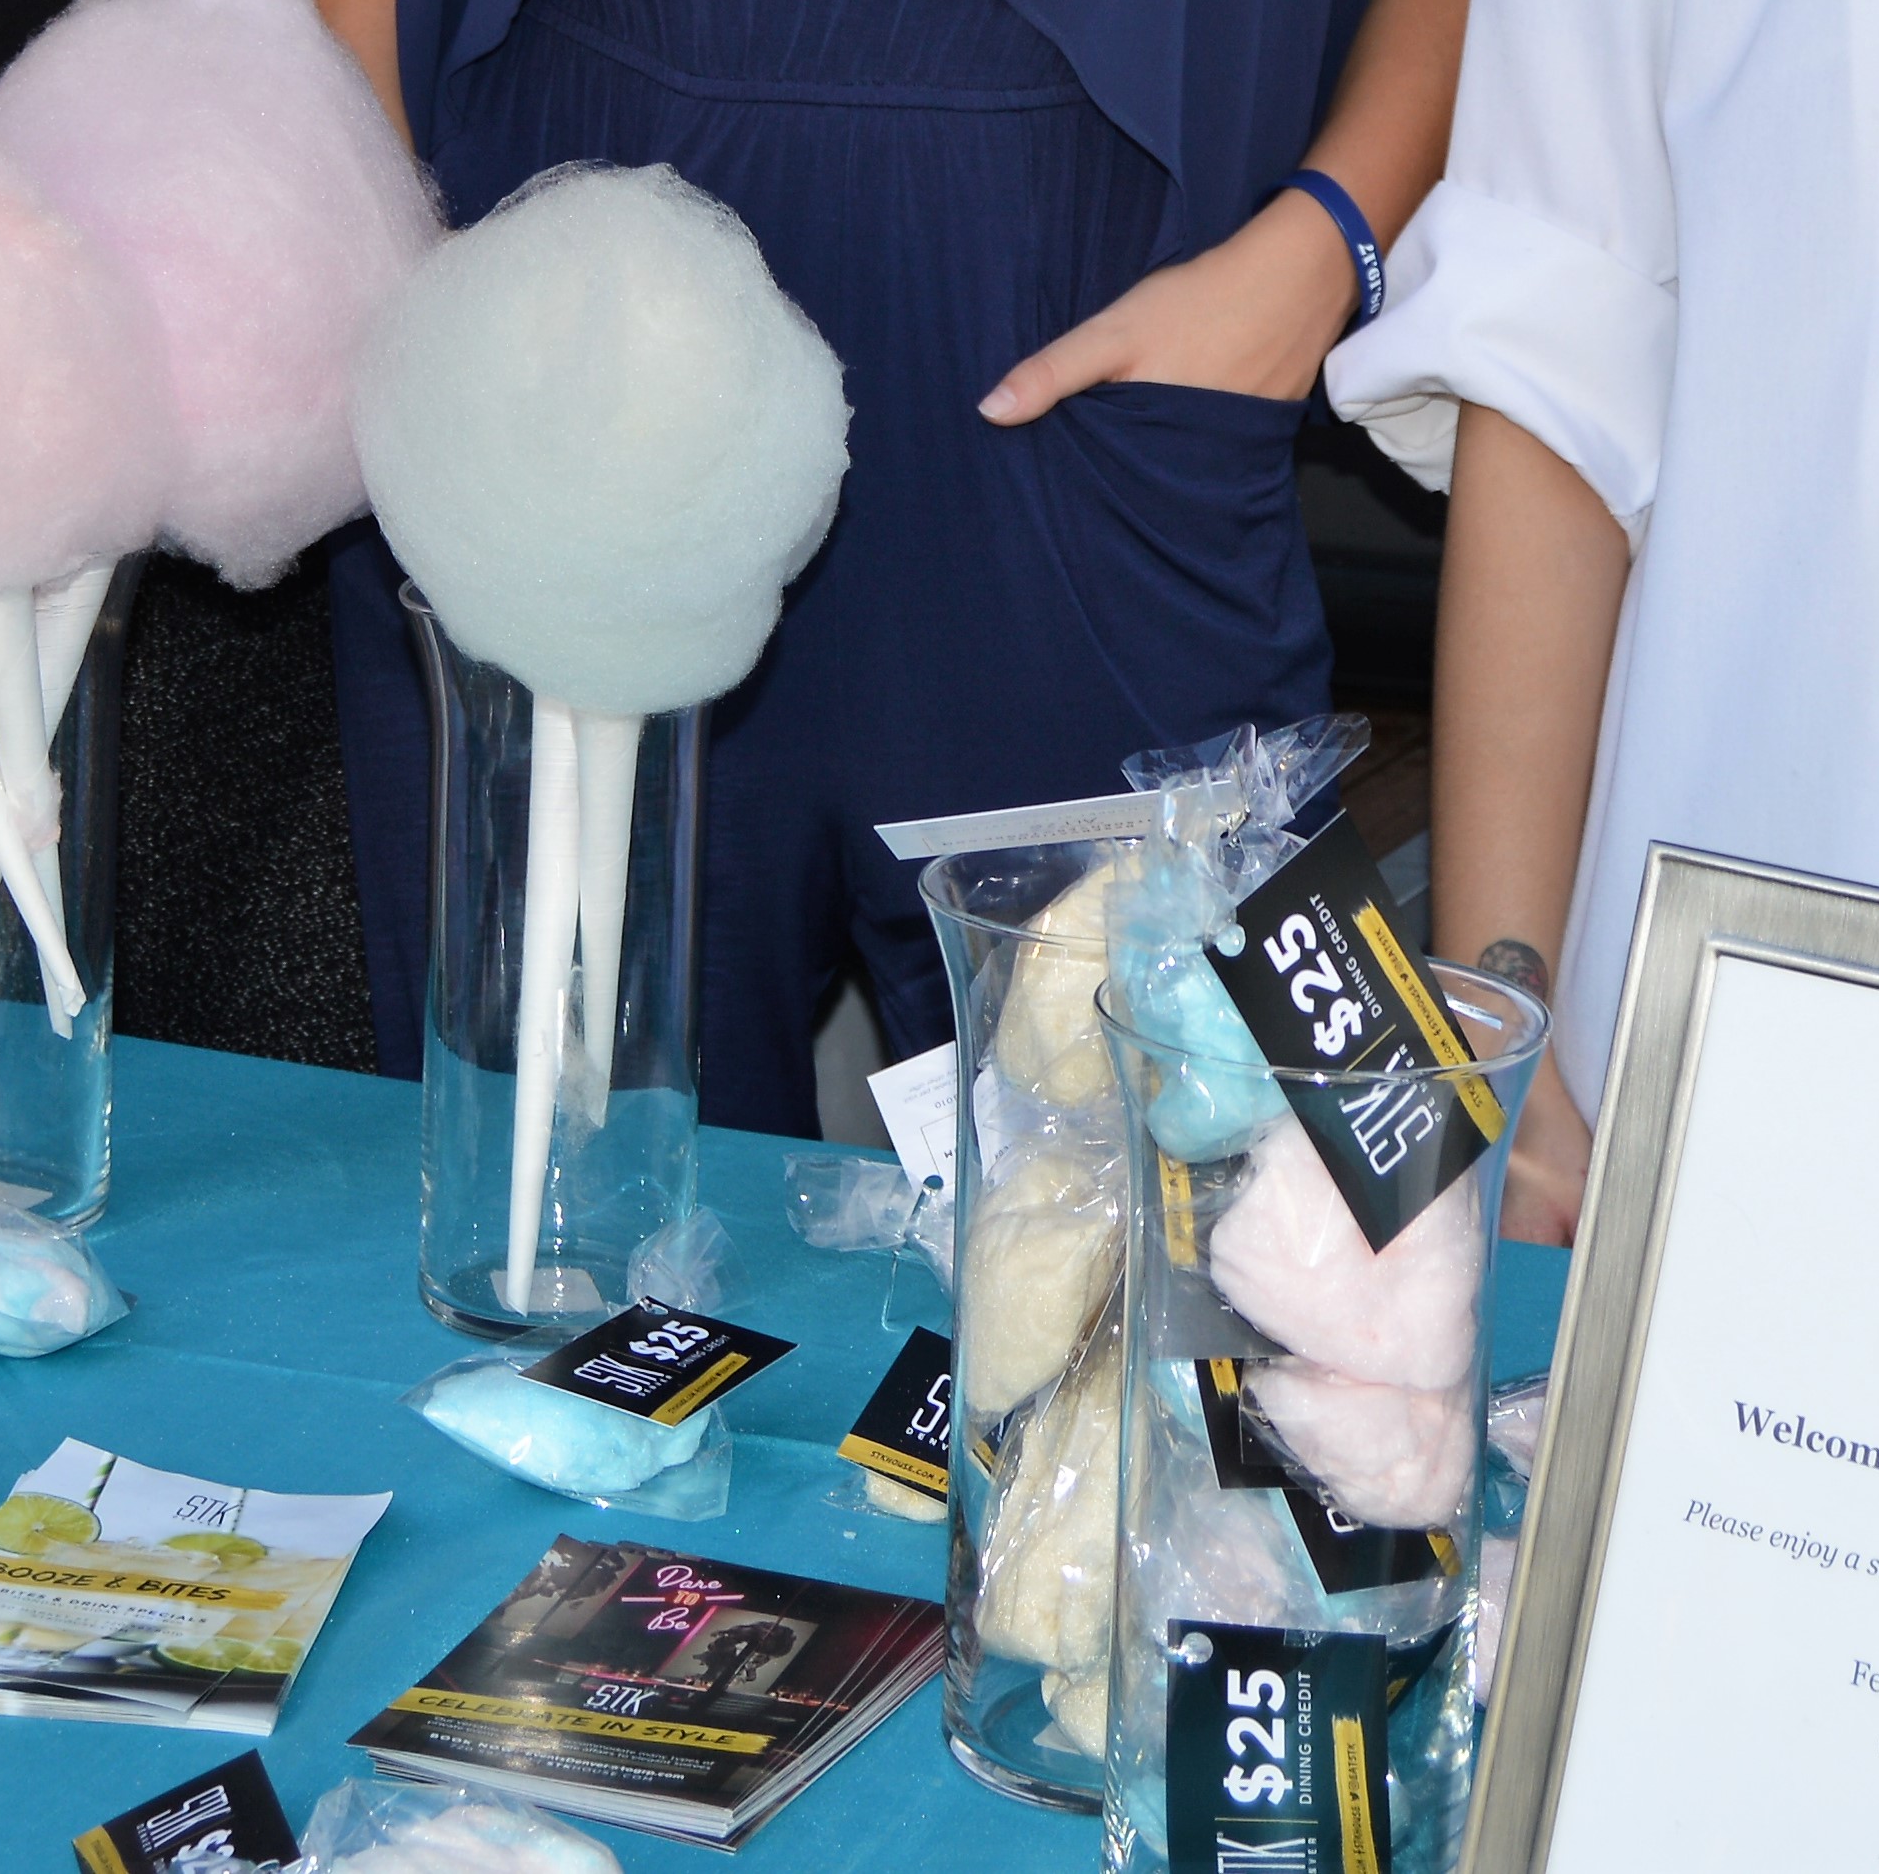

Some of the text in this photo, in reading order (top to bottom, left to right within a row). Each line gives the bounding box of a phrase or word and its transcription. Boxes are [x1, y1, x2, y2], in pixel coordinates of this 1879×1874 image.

[1309, 893, 1384, 1020] DINING CREDIT
[1263, 913, 1365, 1057] $25
[1341, 1051, 1435, 1175] STK
[629, 1320, 709, 1361] $25
[574, 1353, 665, 1395] STK
[176, 1494, 239, 1526] STK
[1683, 1499, 1764, 1544] Please
[1769, 1524, 1839, 1569] enjoy
[1844, 1551, 1862, 1572] a
[104, 1576, 122, 1589] &
[136, 1578, 232, 1601] BITES
[656, 1564, 722, 1589] Dare
[0, 1588, 45, 1601] BITES
[69, 1599, 118, 1611] DRINK
[127, 1606, 208, 1624] SPECIALS
[673, 1590, 700, 1605] TO
[646, 1607, 690, 1630] Be
[586, 1684, 656, 1717] STK
[429, 1732, 471, 1745] BOOK
[600, 1720, 634, 1733] IN
[642, 1725, 737, 1745] STYLE
[1223, 1669, 1293, 1805] $25
[1297, 1671, 1313, 1805] DINING CREDIT
[147, 1784, 231, 1848] STK
